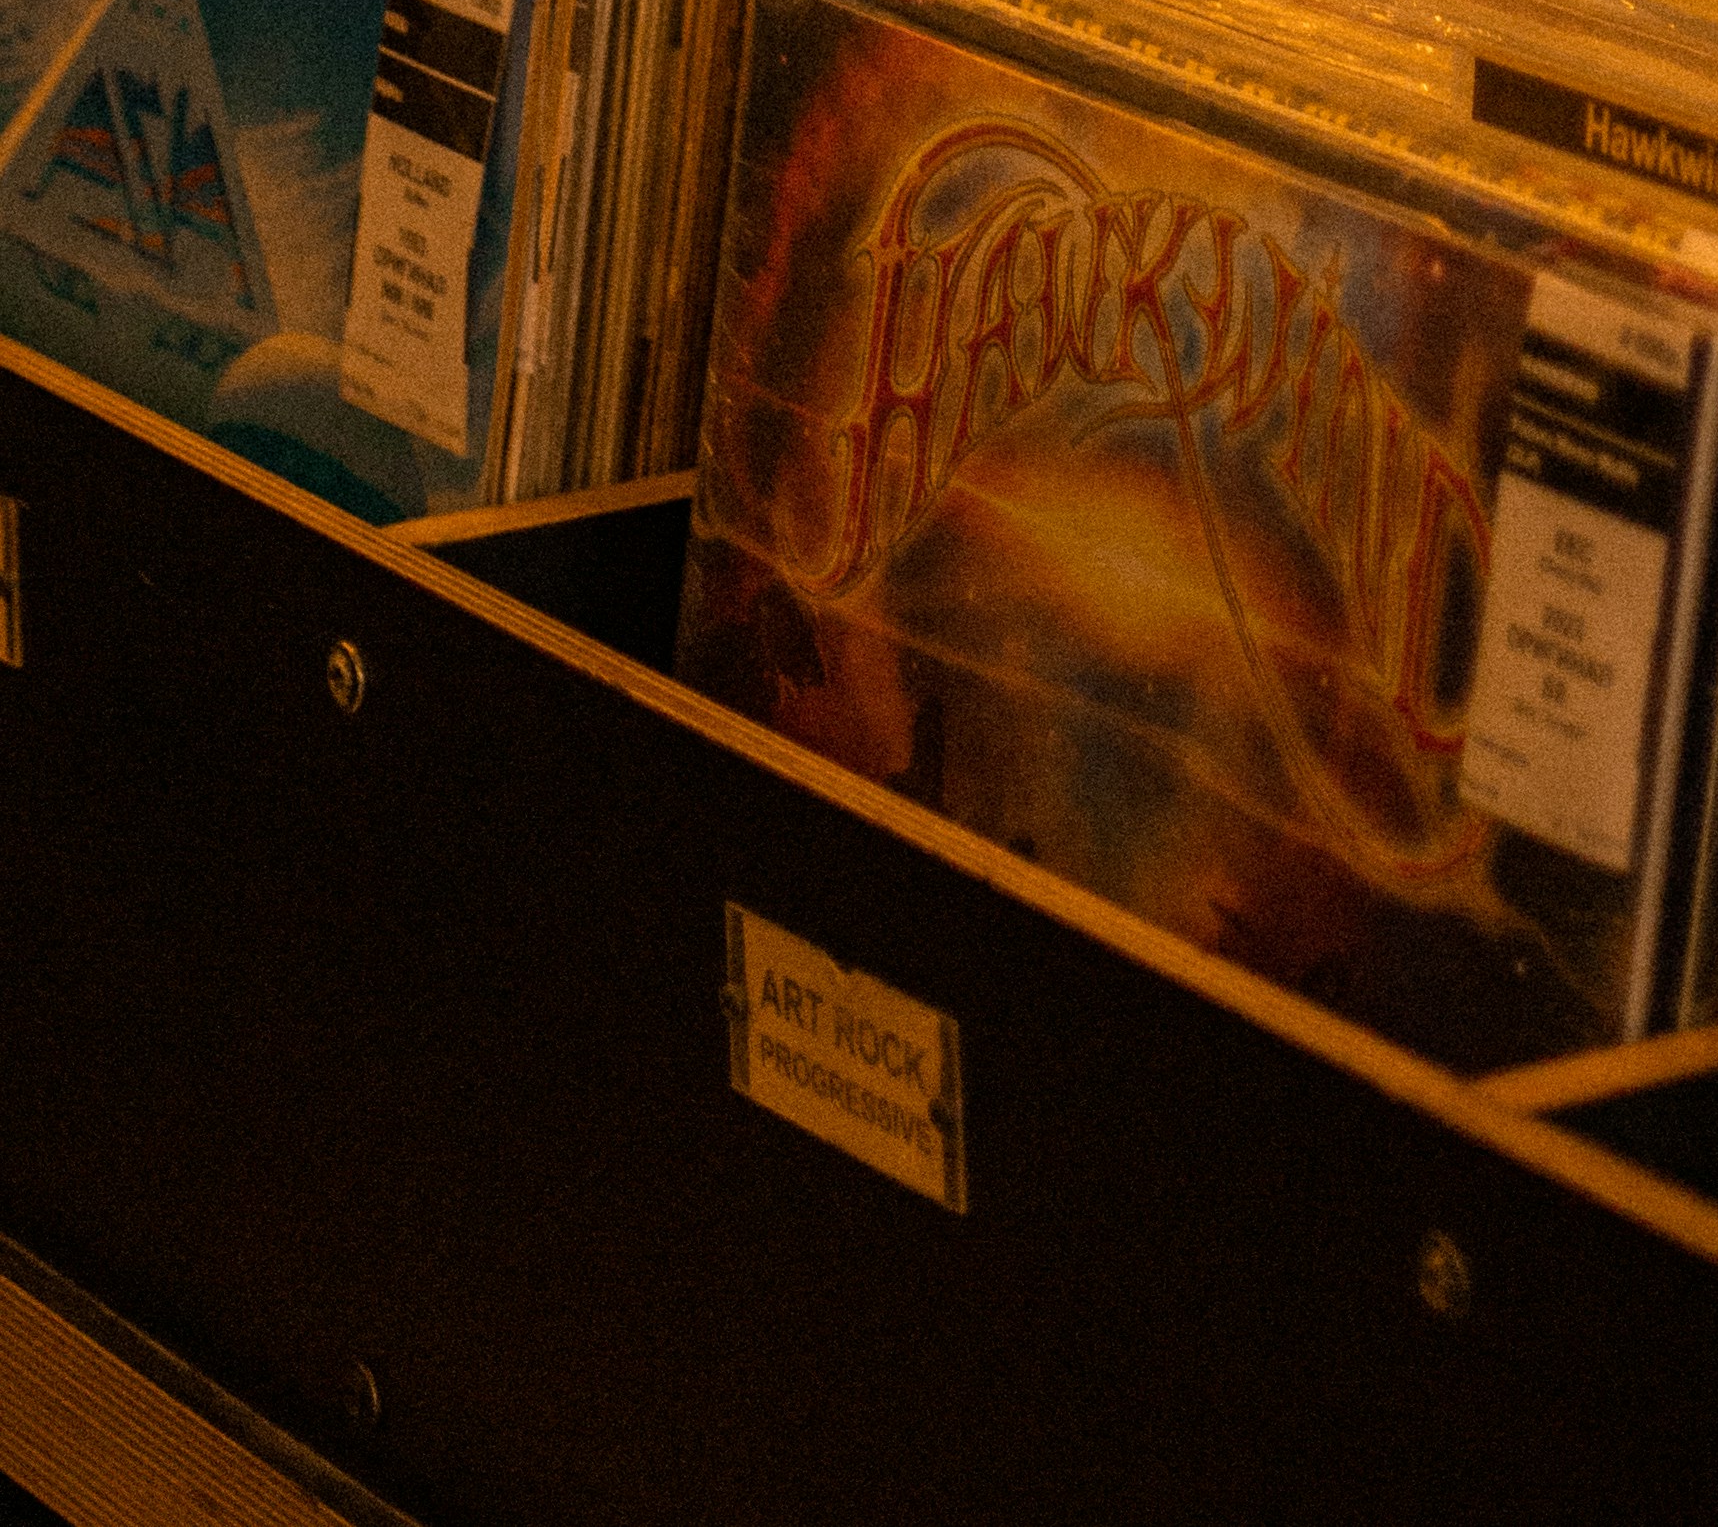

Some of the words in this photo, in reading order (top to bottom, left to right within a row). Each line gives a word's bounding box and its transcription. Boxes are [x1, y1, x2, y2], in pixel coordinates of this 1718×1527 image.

[785, 114, 1497, 819] HAWKWIND
[759, 967, 823, 1034] ART
[833, 1008, 930, 1097] ROCK
[759, 1034, 933, 1157] PROGRESSIVE
